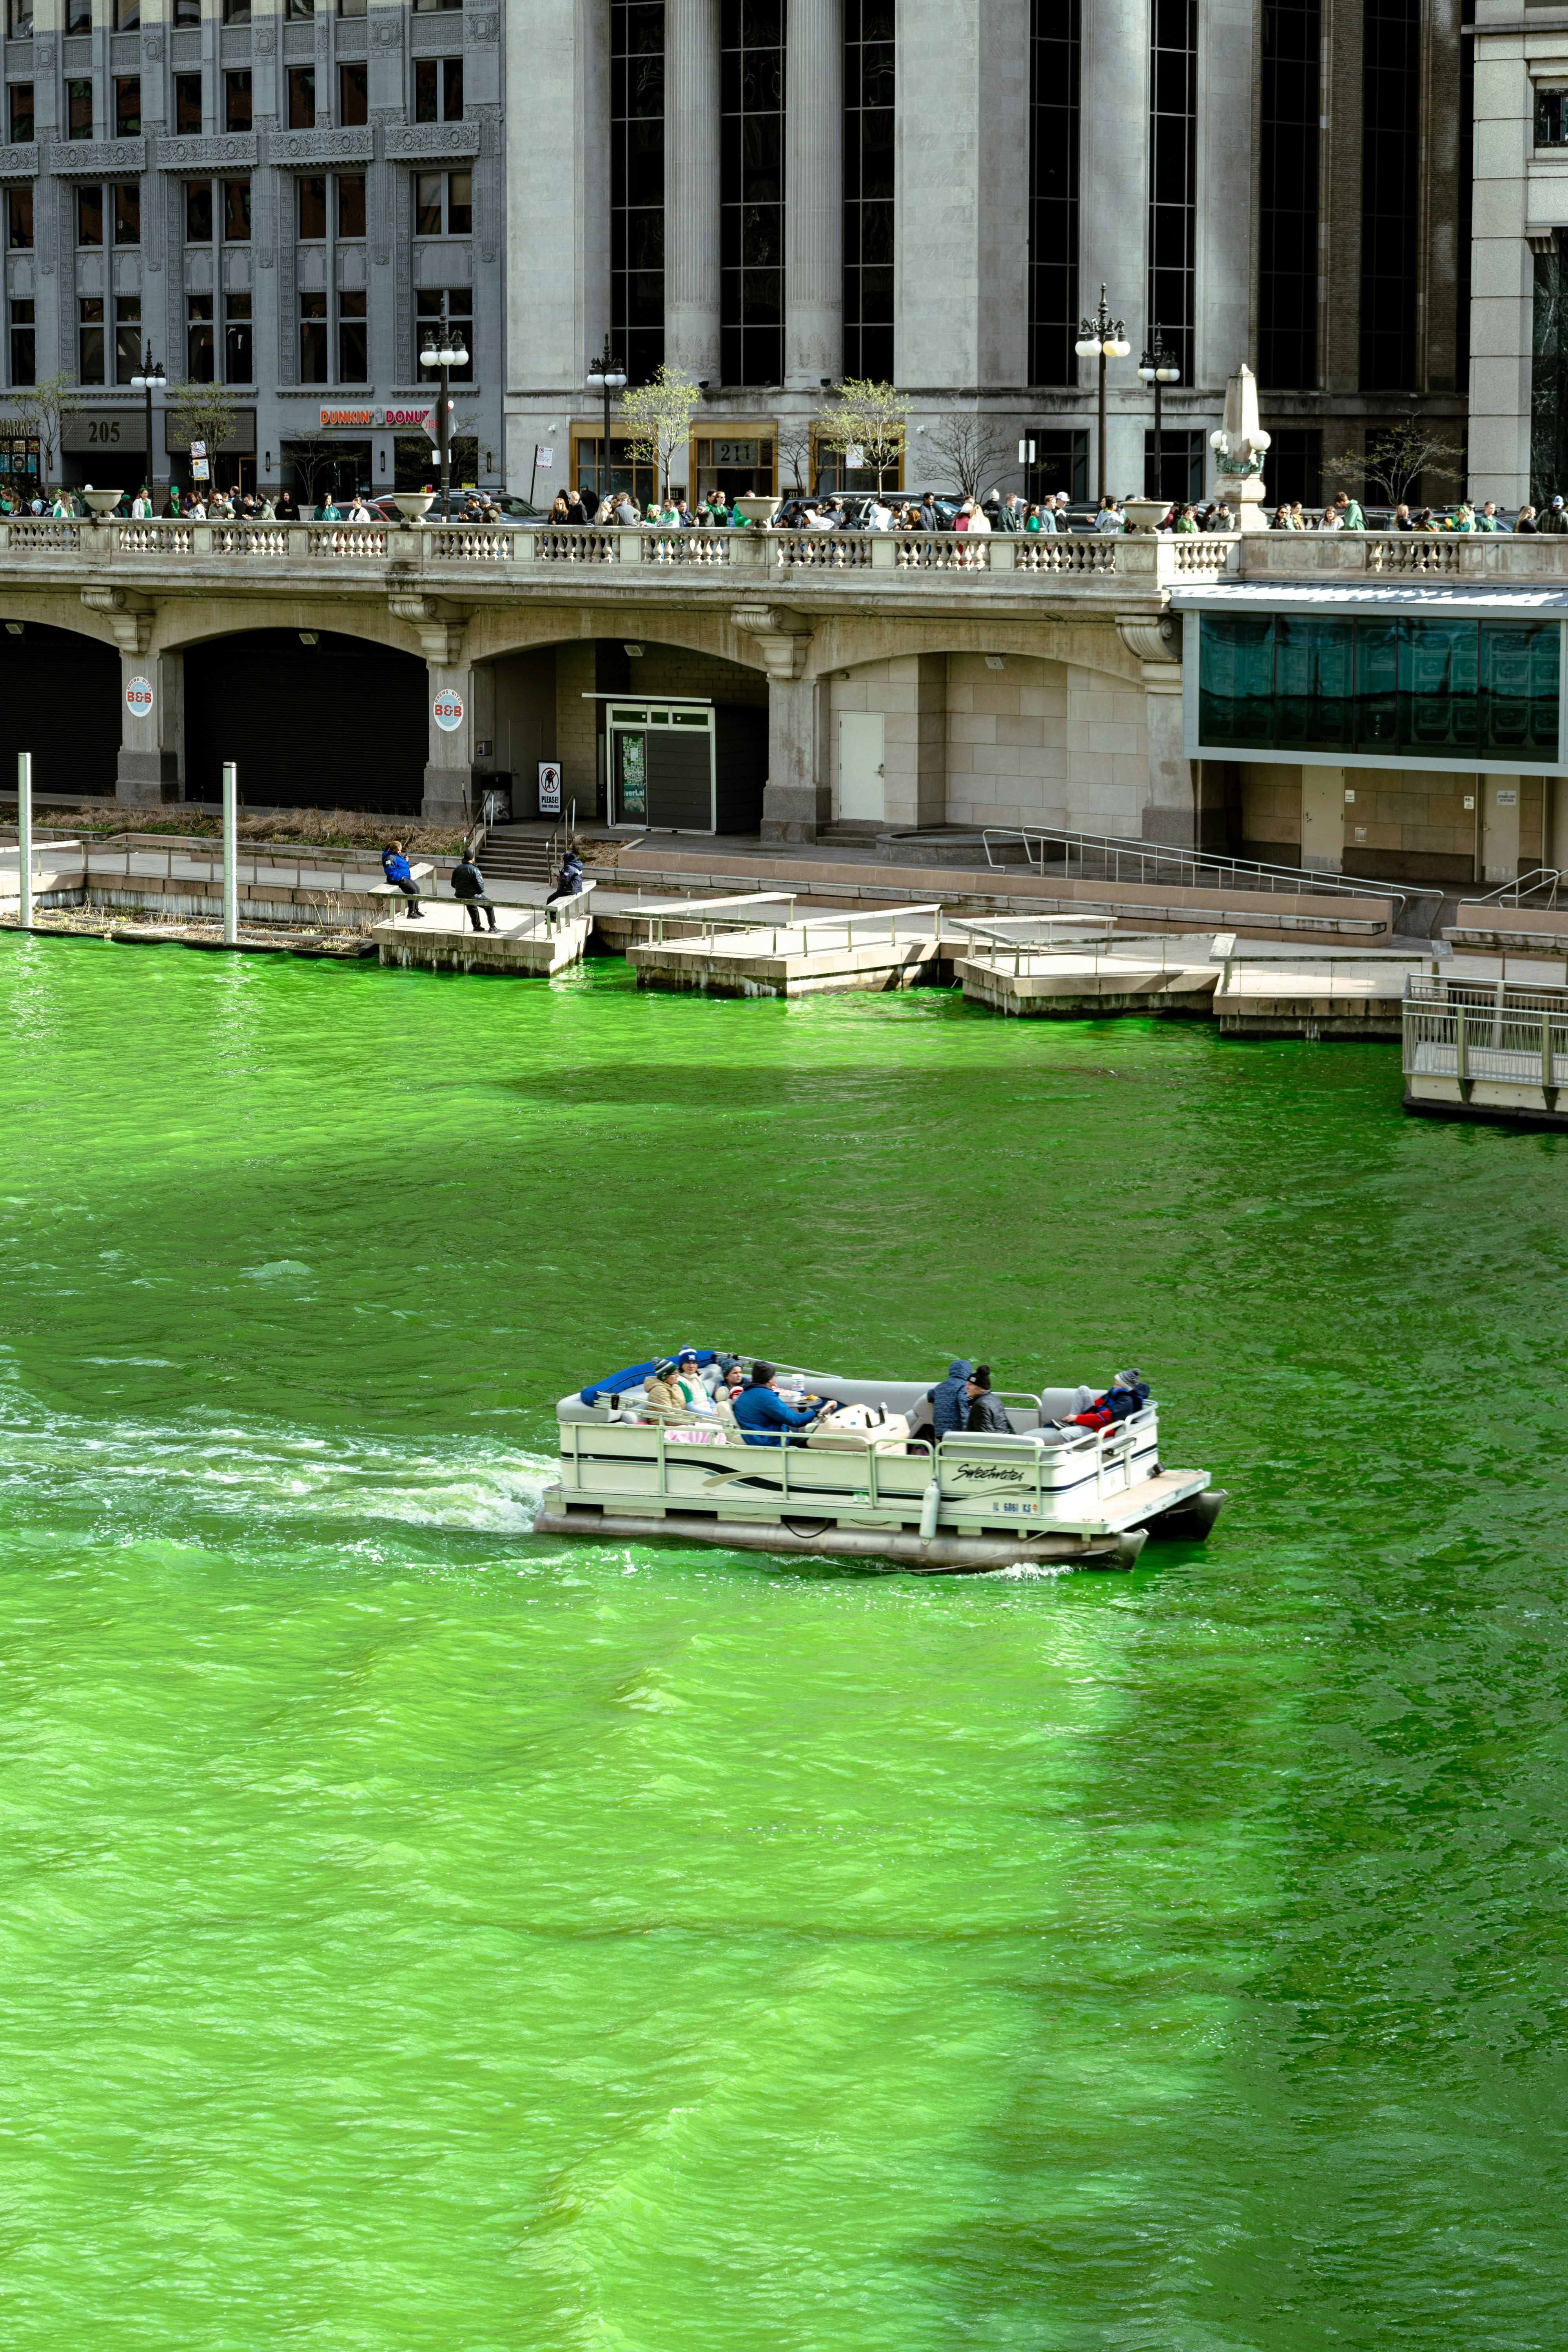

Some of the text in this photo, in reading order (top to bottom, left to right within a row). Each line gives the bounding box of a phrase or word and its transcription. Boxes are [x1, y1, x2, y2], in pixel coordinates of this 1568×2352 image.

[320, 410, 372, 424] DUNKIN'
[88, 421, 120, 442] 205
[720, 445, 749, 461] 211
[127, 677, 152, 692] BREWS BITES
[127, 691, 152, 703] B&B
[435, 690, 462, 705] BREWS BITES
[435, 704, 462, 717] B&B
[951, 1463, 1025, 1481] Sweetwater
